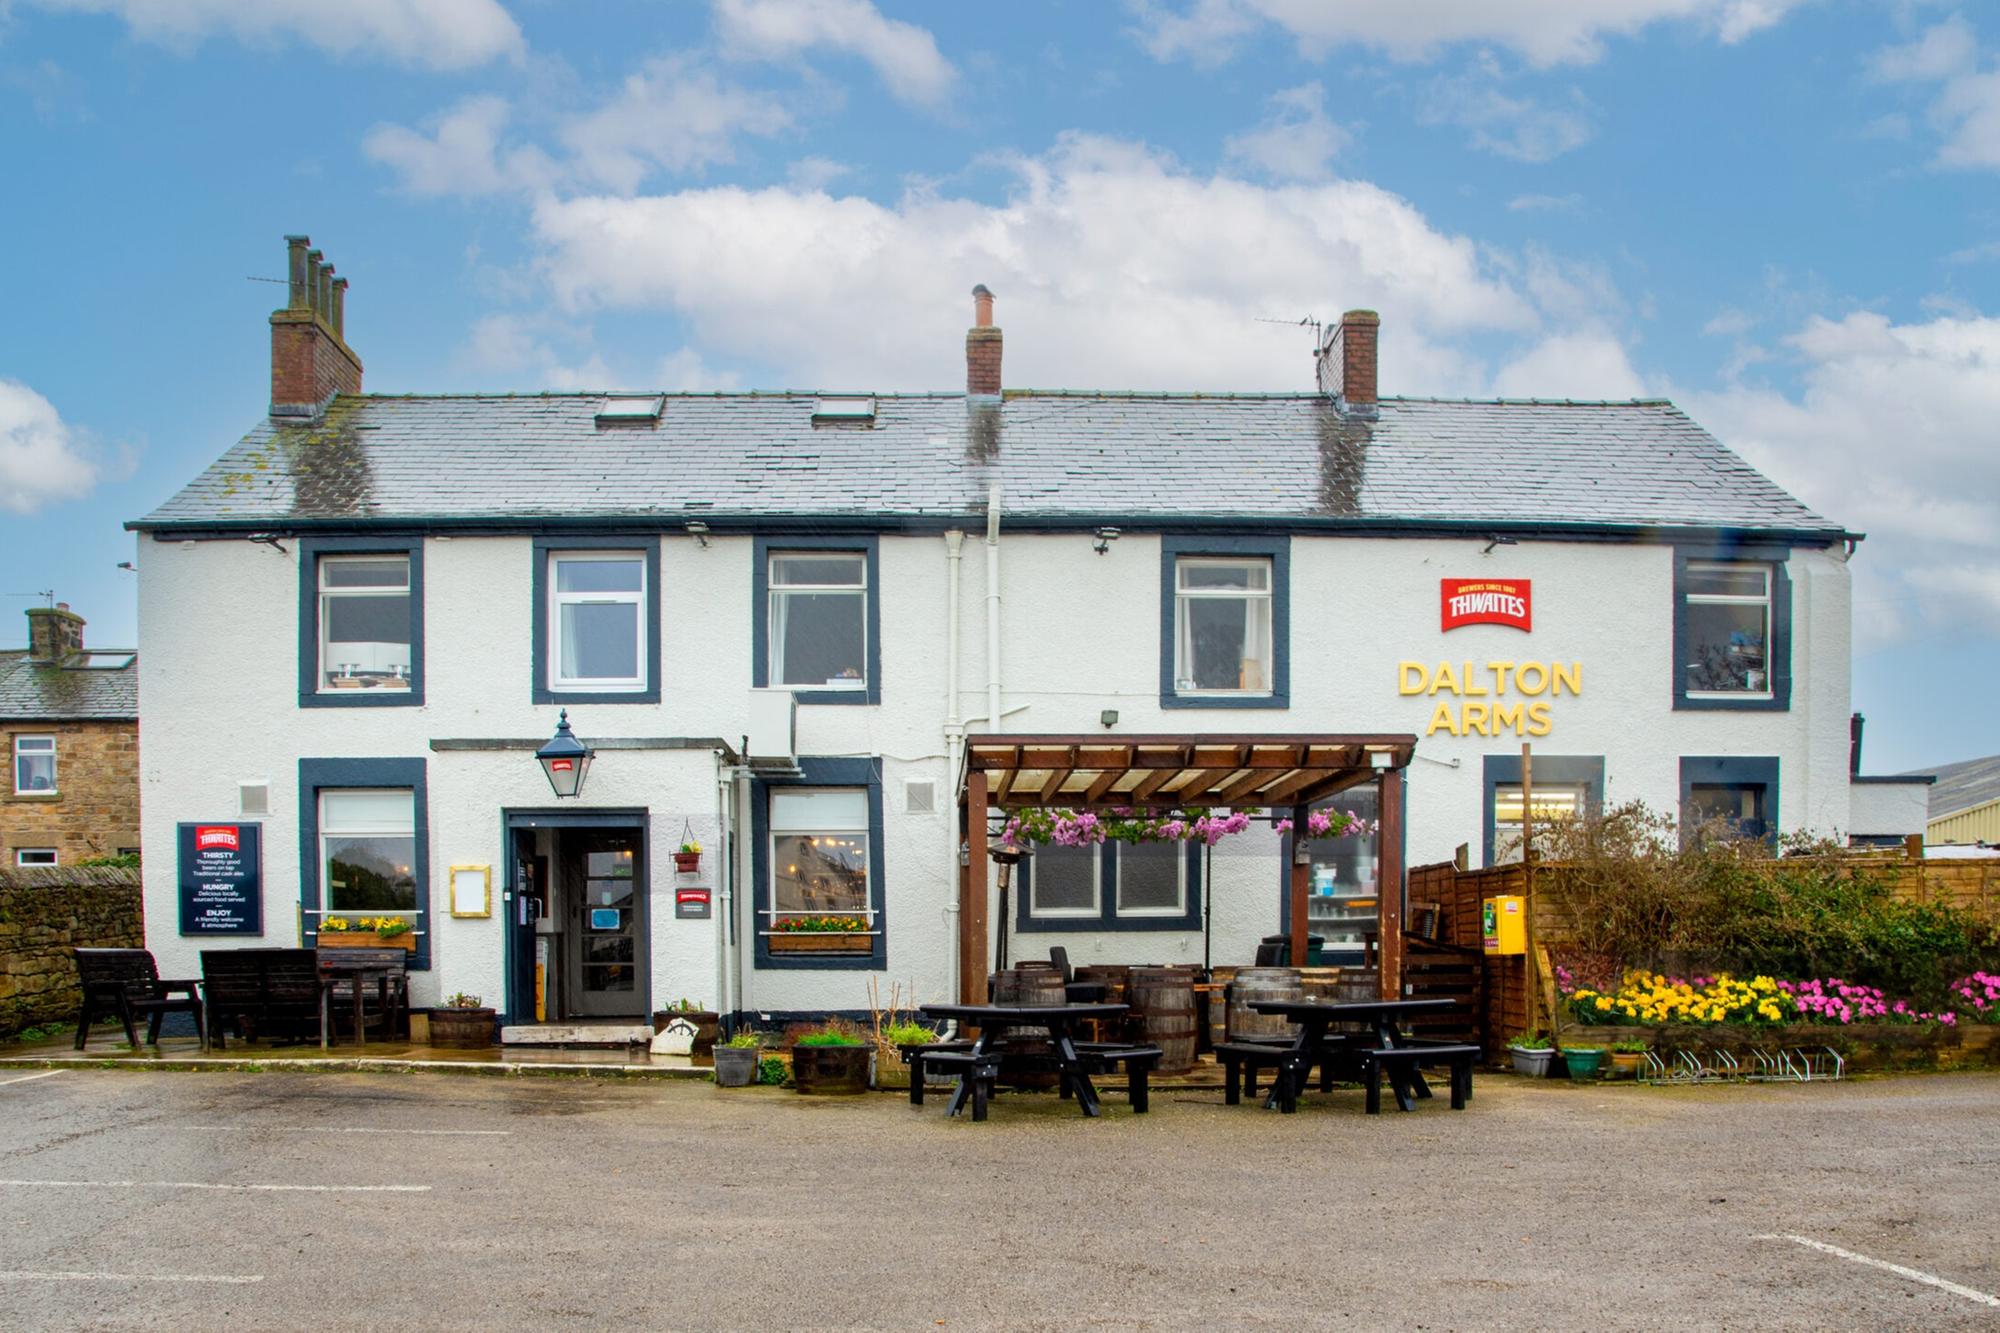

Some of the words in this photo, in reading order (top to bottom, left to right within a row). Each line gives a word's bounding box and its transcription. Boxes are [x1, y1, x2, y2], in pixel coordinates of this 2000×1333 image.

[1458, 584, 1484, 594] BREWERS
[1485, 583, 1502, 591] SINCE
[1448, 592, 1525, 617] THWAITES
[1398, 660, 1583, 697] DALTON
[1426, 701, 1553, 737] ARMS
